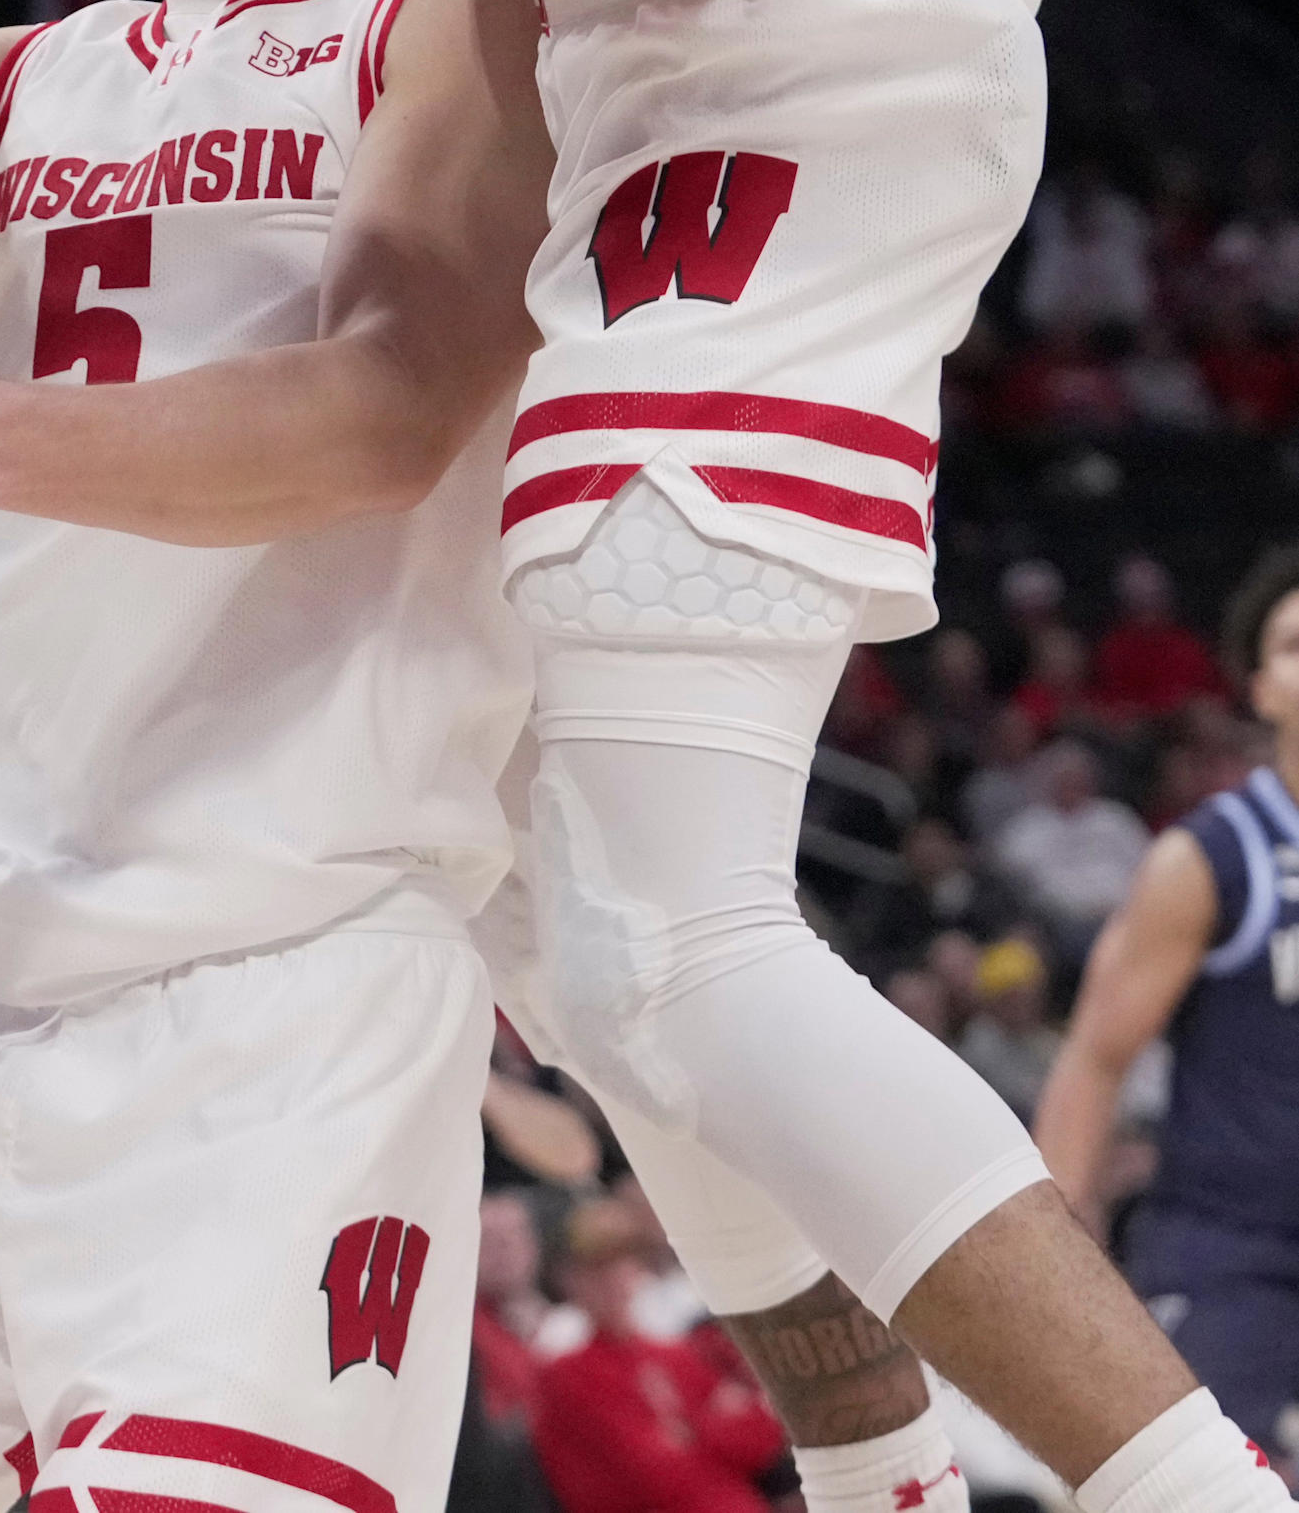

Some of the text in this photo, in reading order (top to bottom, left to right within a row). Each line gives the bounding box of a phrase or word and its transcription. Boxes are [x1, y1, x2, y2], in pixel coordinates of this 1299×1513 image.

[33, 214, 152, 385] 5
[585, 150, 799, 330] W
[319, 1216, 430, 1383] W
